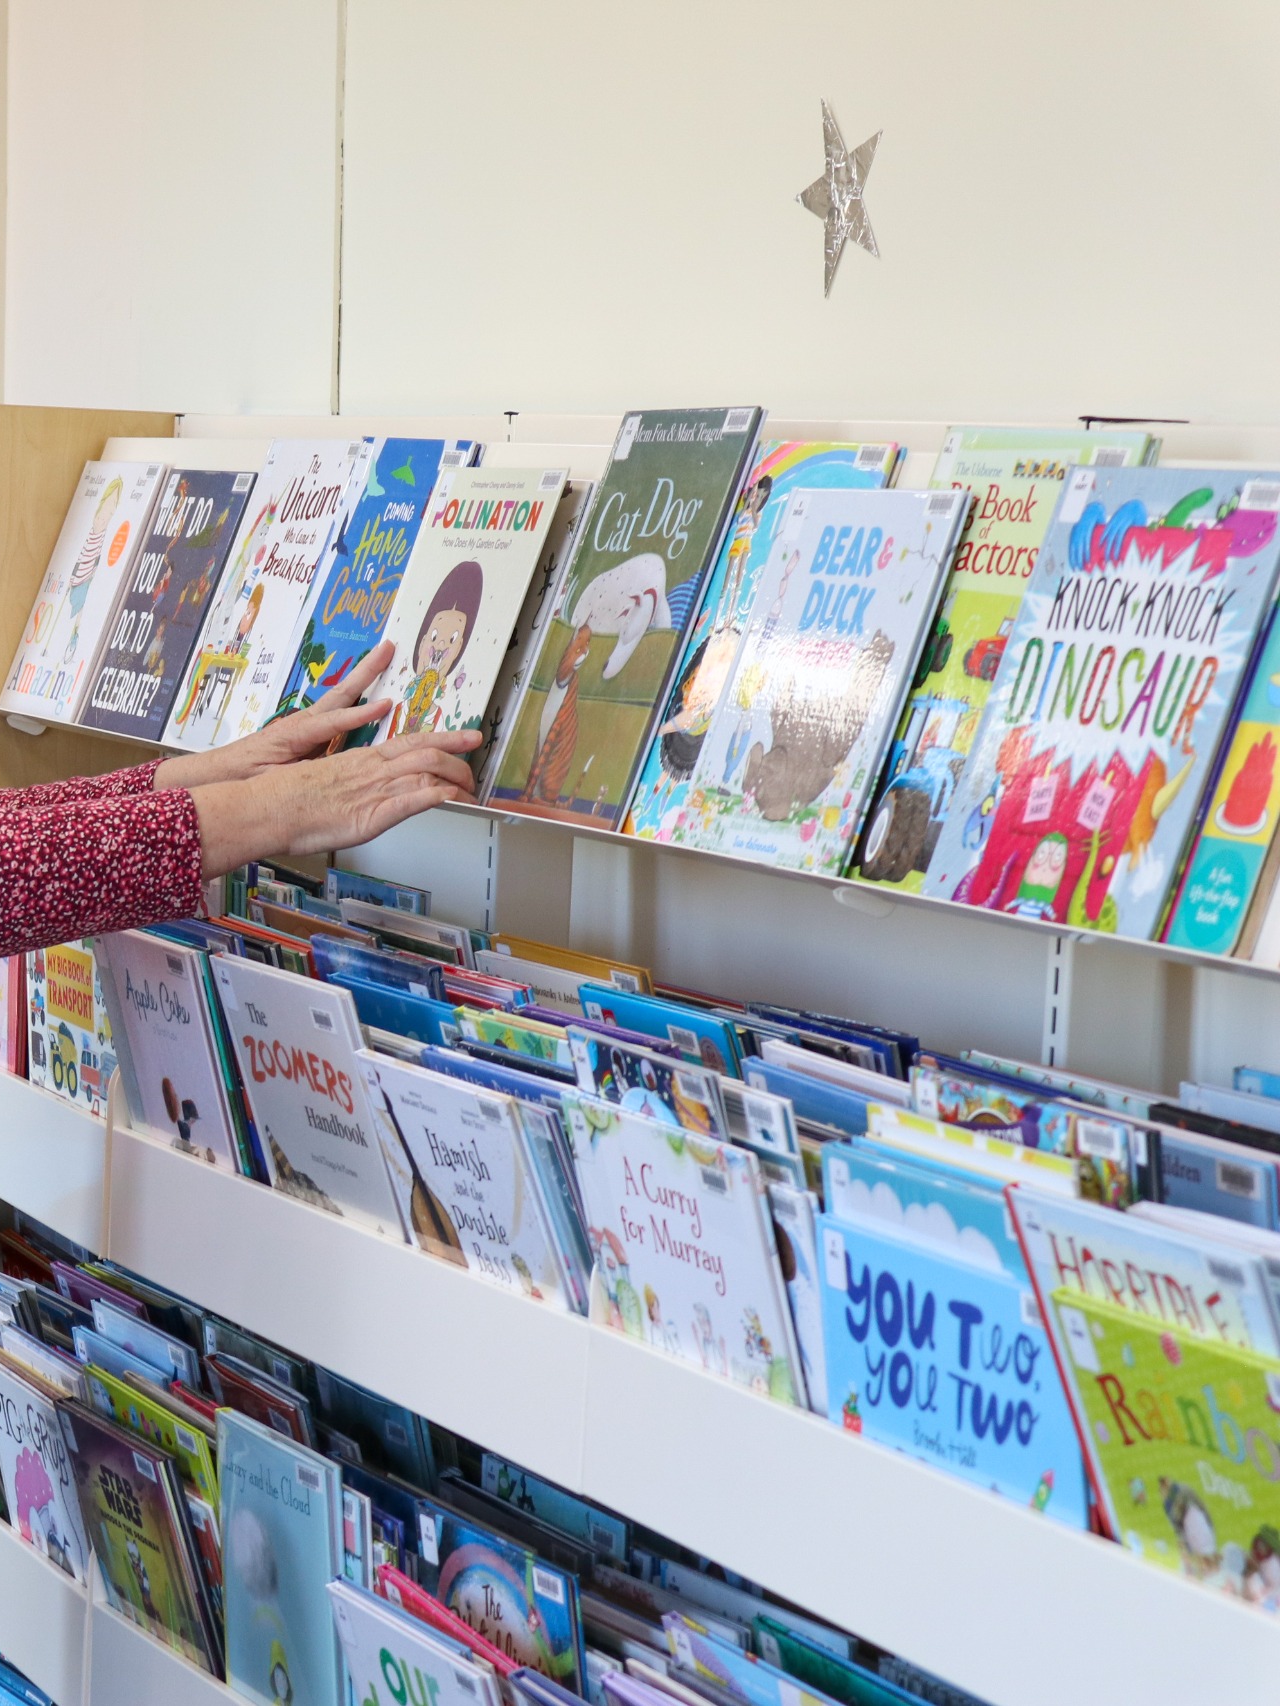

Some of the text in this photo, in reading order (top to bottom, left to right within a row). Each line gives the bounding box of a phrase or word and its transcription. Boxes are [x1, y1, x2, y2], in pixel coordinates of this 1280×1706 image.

[652, 423, 666, 442] Fox
[667, 423, 677, 442] &
[677, 422, 697, 442] Mark
[696, 422, 724, 447] Teague
[307, 454, 322, 475] The
[956, 462, 1003, 478] The Usborne
[153, 495, 214, 538] WHAT DO
[280, 476, 341, 523] Unicorn
[383, 501, 415, 522] COMING
[593, 478, 703, 560] Cat Dog
[979, 483, 1038, 522] Book
[442, 537, 512, 551] How Does My Garden Grow?
[810, 525, 893, 578] BEAR &
[979, 520, 995, 539] of
[132, 553, 166, 594] YOU
[262, 542, 320, 585] Breakfast
[954, 541, 1040, 578] actors
[322, 565, 404, 633] Country
[798, 579, 876, 635] DUCK
[1047, 576, 1236, 646] KNOCK KNOCK
[110, 609, 154, 654] DO TO
[6, 652, 84, 715] Amazing!
[91, 666, 161, 718] CELEBRATE?
[1005, 637, 1218, 755] DINOSAUR
[47, 953, 57, 973] MY
[47, 978, 93, 1020] TRANSPORT
[126, 967, 190, 1025] Apple Cake
[245, 1001, 268, 1028] The
[242, 1035, 354, 1115] ZOOMERS'
[304, 1106, 369, 1149] Handbook
[423, 1126, 491, 1182] Hamish
[623, 1155, 702, 1239] A Curry
[451, 1204, 509, 1246] Double
[472, 1241, 513, 1284] Bass
[620, 1205, 726, 1297] for Murray
[27, 1403, 70, 1487] GRUB
[1096, 1373, 1280, 1482] Rainbo
[98, 1464, 139, 1506] STAR
[101, 1484, 143, 1529] WARS
[249, 1463, 264, 1491] and
[266, 1468, 279, 1500] the
[280, 1475, 311, 1517] Cloud
[481, 1584, 503, 1621] The
